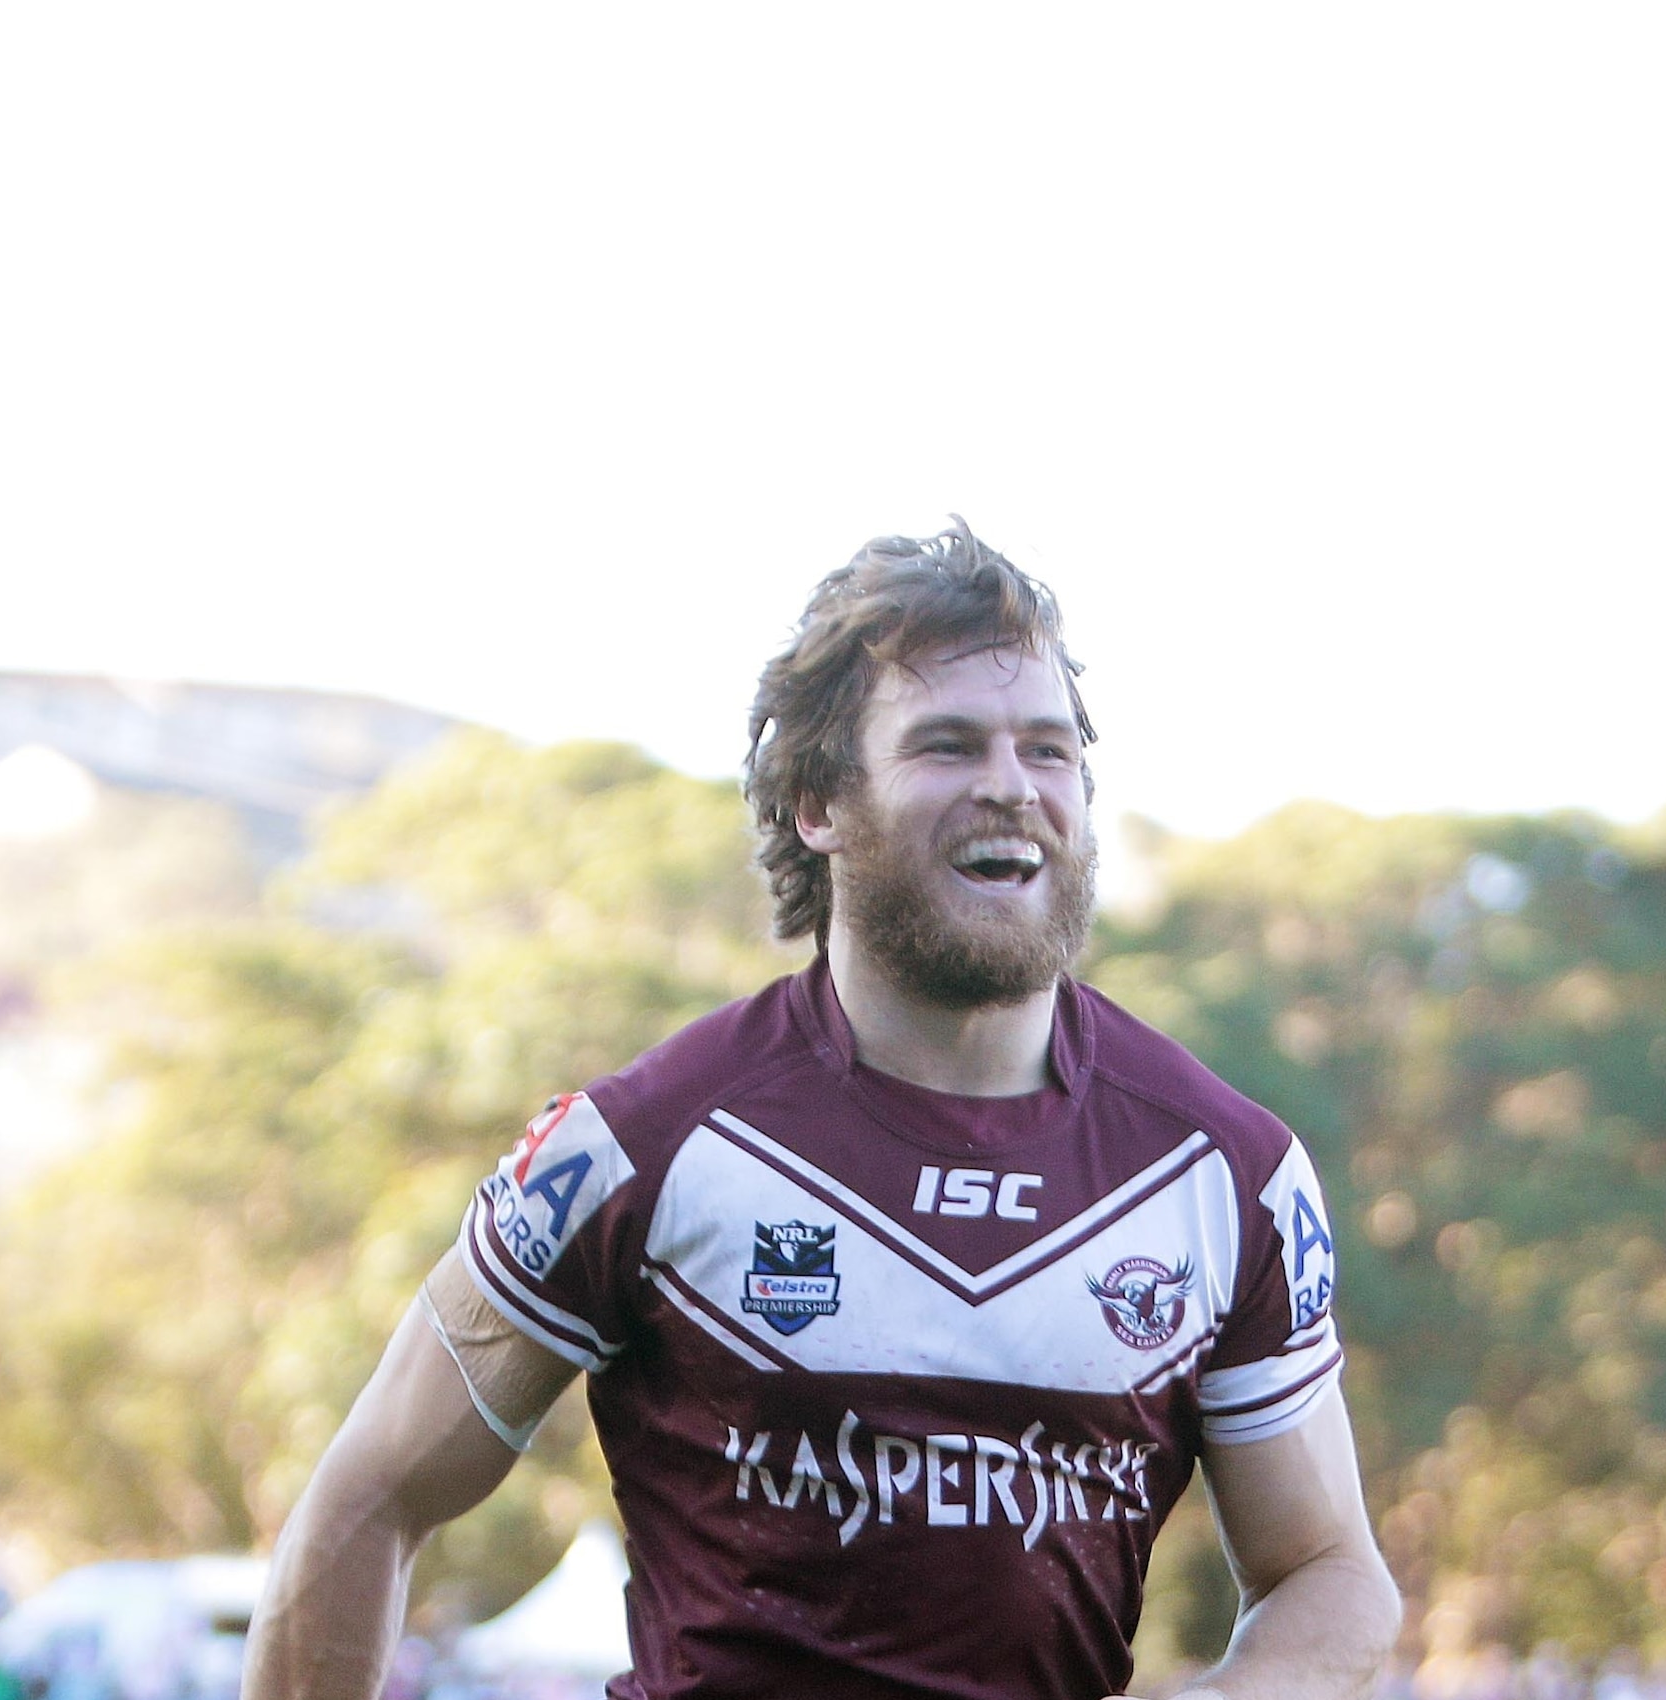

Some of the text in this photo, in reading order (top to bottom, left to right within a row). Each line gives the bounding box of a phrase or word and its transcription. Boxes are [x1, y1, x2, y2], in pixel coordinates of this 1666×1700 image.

[912, 1165, 1044, 1222] ISC
[772, 1226, 819, 1241] NRL
[757, 1278, 828, 1293] Telstra
[744, 1300, 837, 1313] PREMIERSHIP
